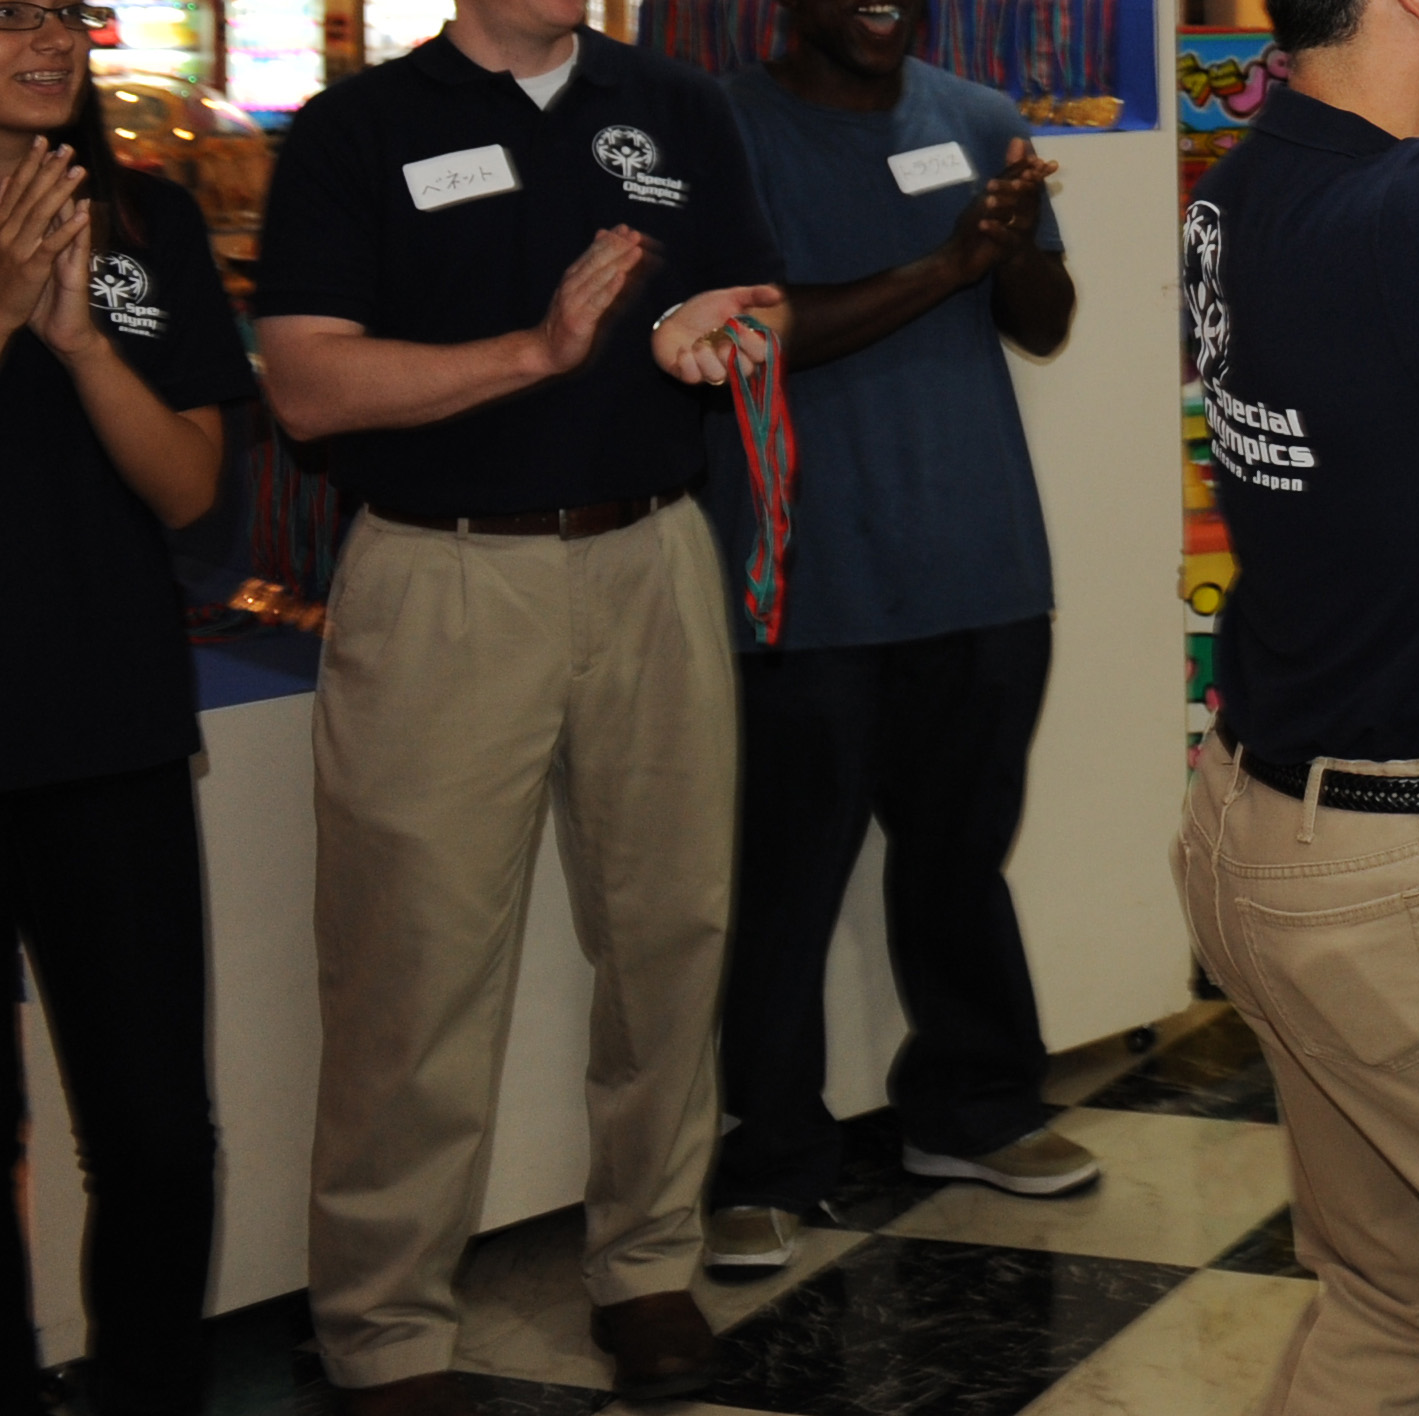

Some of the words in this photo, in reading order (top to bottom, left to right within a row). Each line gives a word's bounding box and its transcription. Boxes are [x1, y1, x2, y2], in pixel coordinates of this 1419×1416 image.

[1204, 396, 1316, 468] Olympics
[1212, 376, 1305, 438] Special
[1252, 470, 1304, 492] Japan
